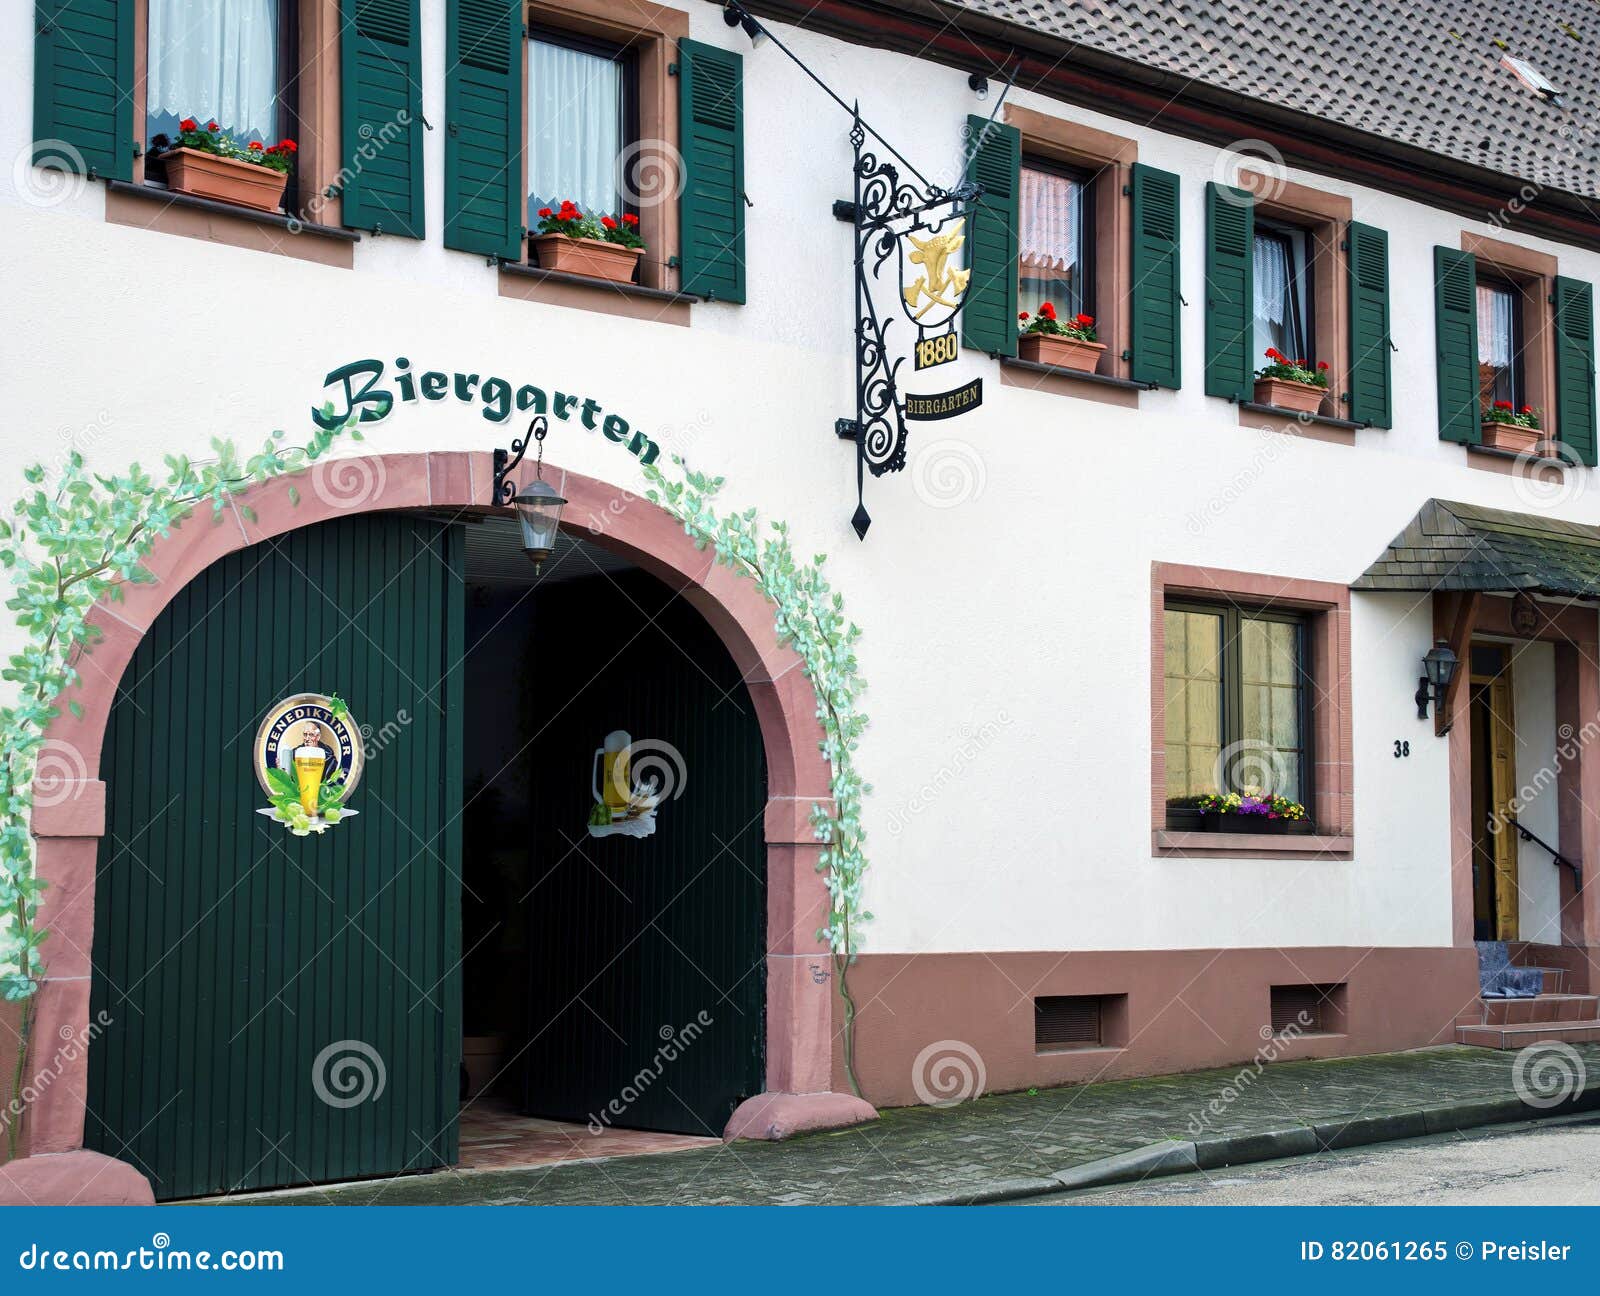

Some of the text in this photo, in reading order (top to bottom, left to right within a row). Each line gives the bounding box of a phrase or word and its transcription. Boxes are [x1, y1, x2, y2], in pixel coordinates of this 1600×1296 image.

[916, 333, 957, 368] 1880
[311, 357, 660, 466] Biergarten
[906, 385, 978, 414] BIERGARTEN
[267, 707, 352, 756] BENEDIKTINER
[1393, 739, 1410, 758] 38
